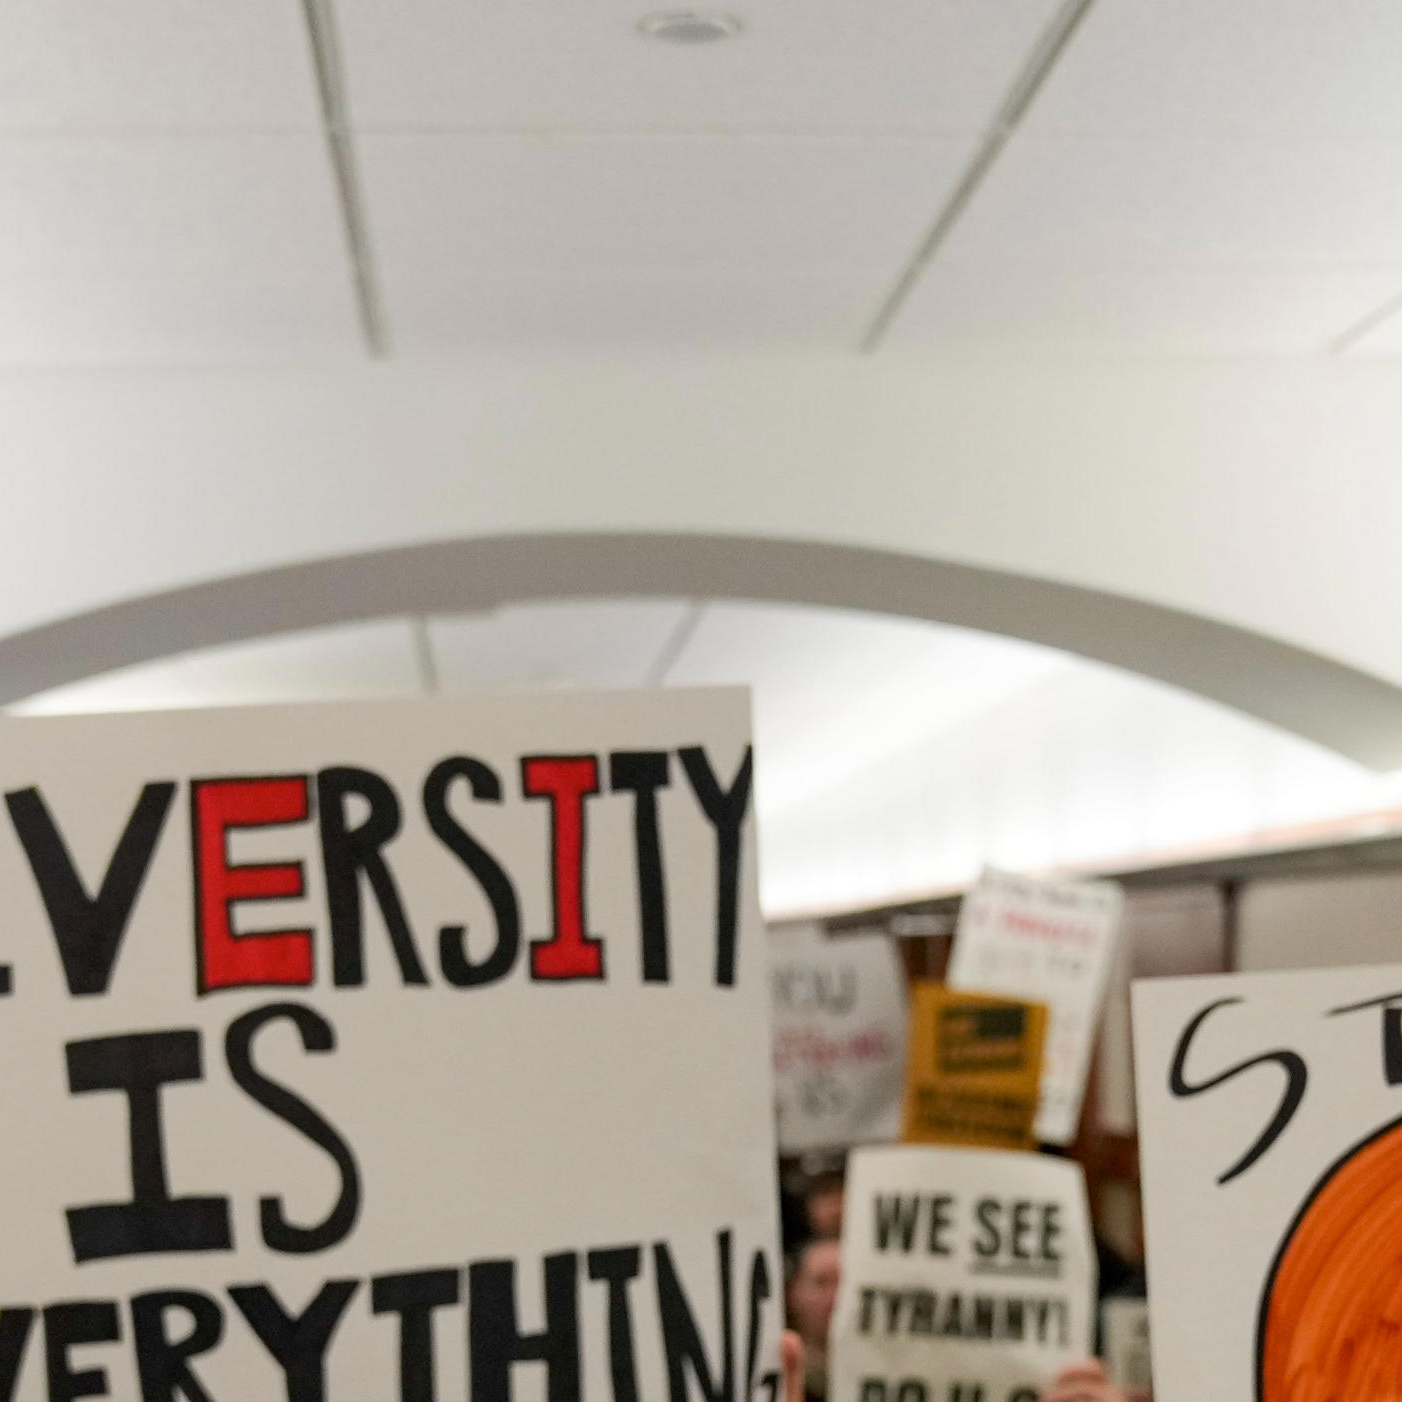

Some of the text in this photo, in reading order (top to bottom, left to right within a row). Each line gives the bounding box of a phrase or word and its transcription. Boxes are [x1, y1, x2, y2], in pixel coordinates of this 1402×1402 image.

[64, 1001, 362, 1264] IS
[874, 1190, 1062, 1260] WE SEE
[859, 1286, 1069, 1347] TYRANNY!
